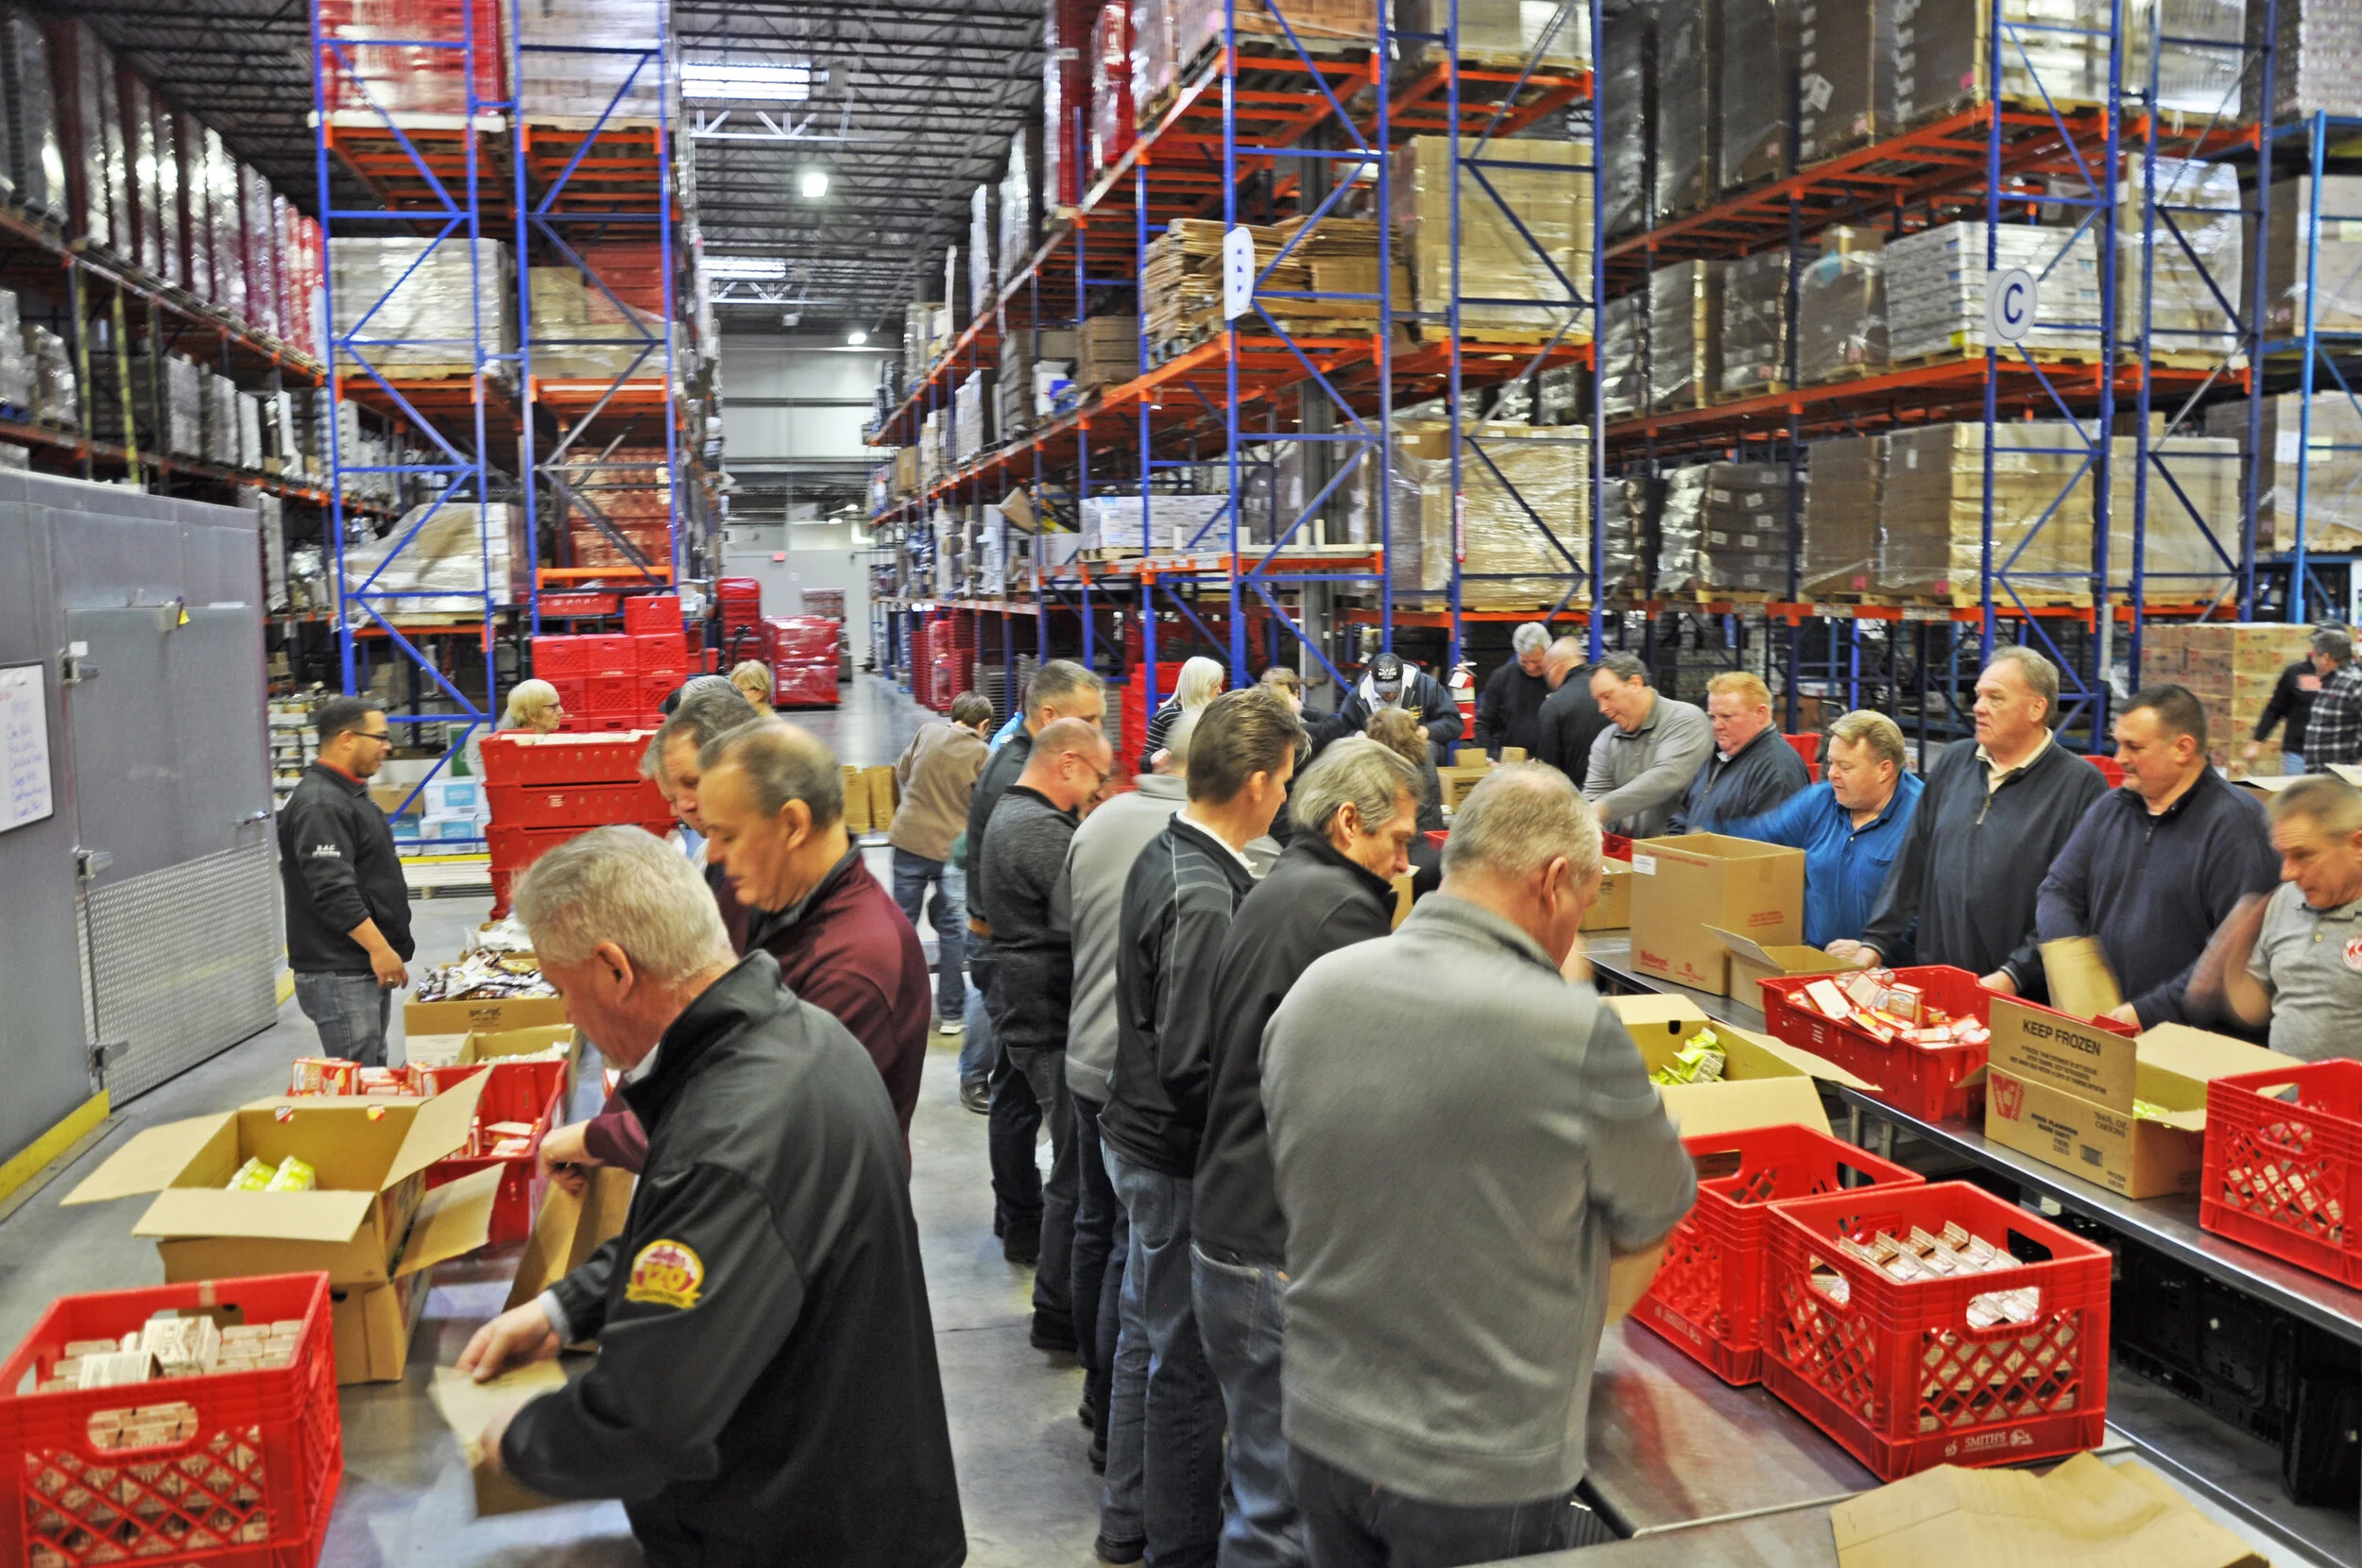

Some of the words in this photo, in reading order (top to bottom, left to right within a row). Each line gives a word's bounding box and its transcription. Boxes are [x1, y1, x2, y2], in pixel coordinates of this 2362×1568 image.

[2004, 282, 2024, 325] C
[2023, 1019, 2053, 1039] KEEP
[2055, 1030, 2101, 1056] FROZEN
[643, 1262, 687, 1291] 120
[1965, 1431, 2007, 1447] SMITH'S
